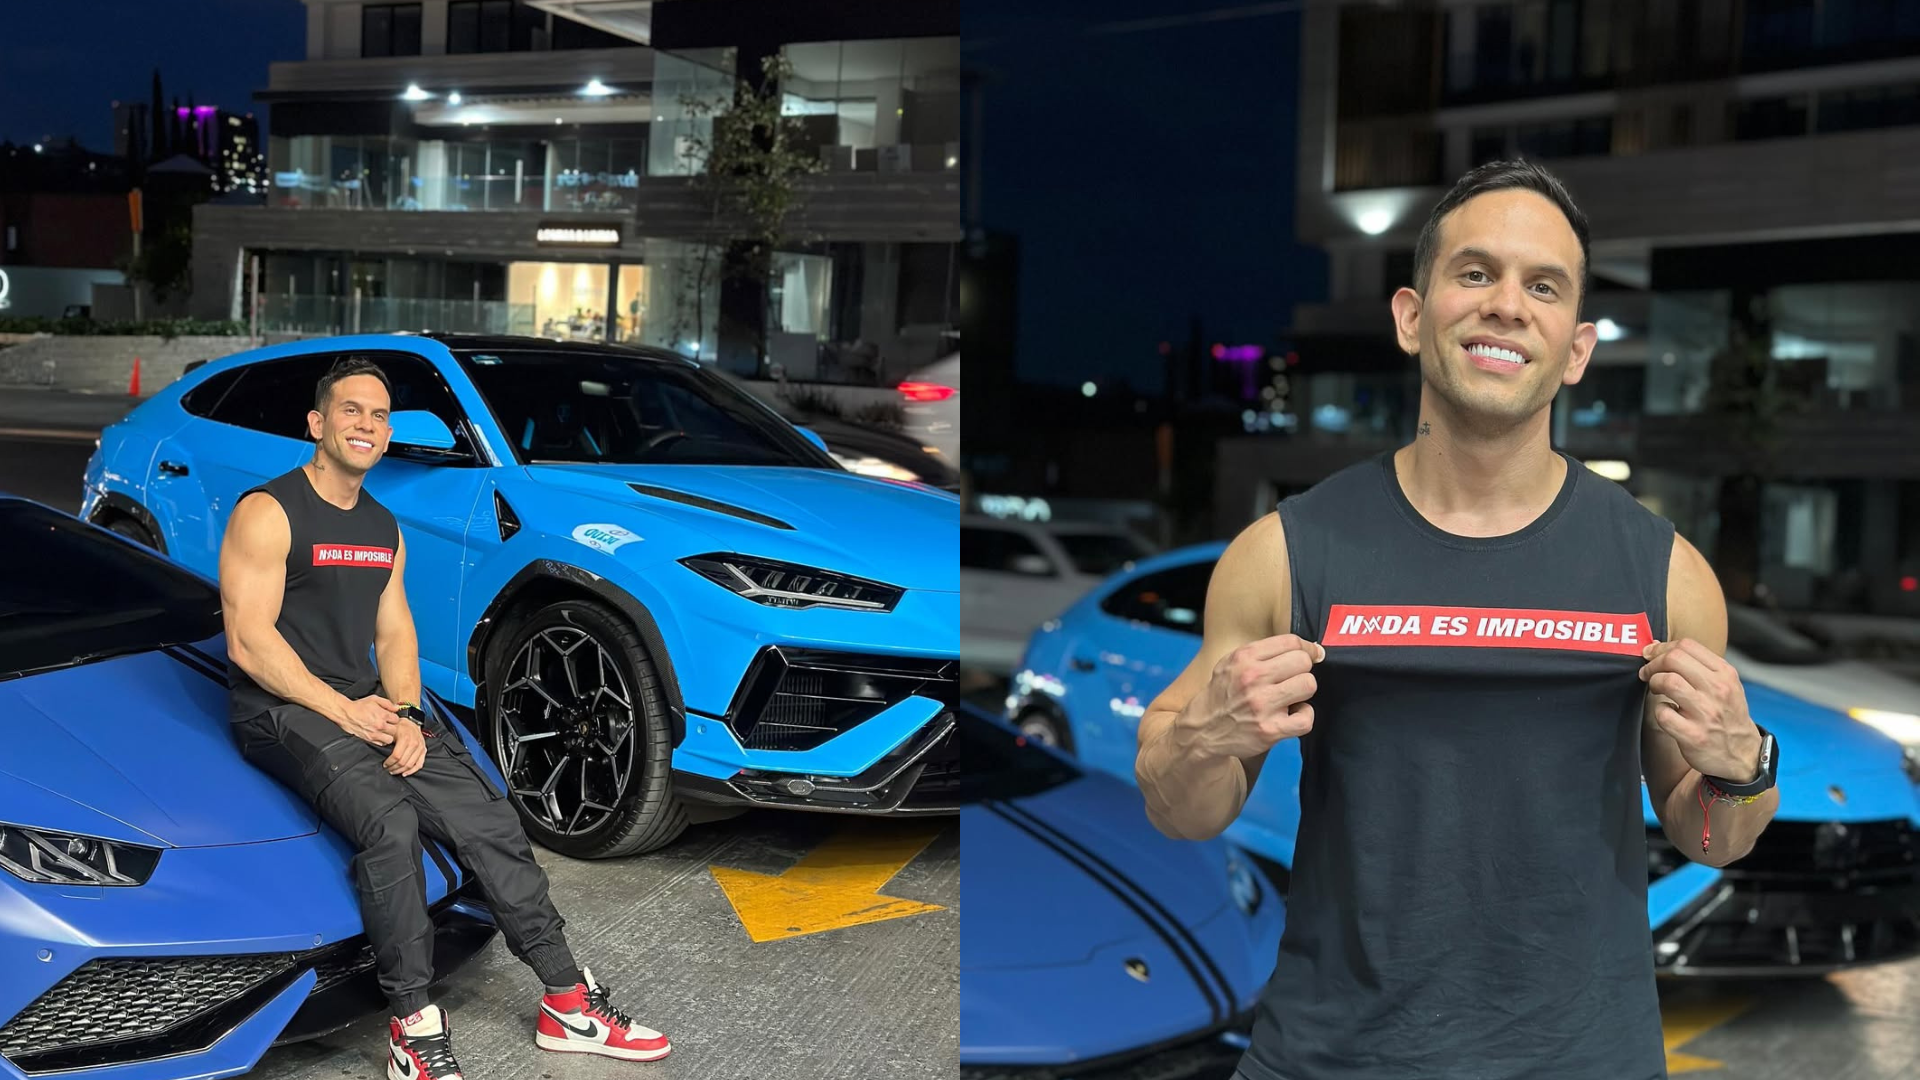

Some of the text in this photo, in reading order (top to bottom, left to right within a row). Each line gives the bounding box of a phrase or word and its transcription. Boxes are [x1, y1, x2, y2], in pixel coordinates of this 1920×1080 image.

[344, 549, 353, 561] ES
[354, 550, 392, 563] IMPOSIBLE
[1430, 616, 1469, 636] ES
[1476, 617, 1639, 644] IMPOSIBLE
